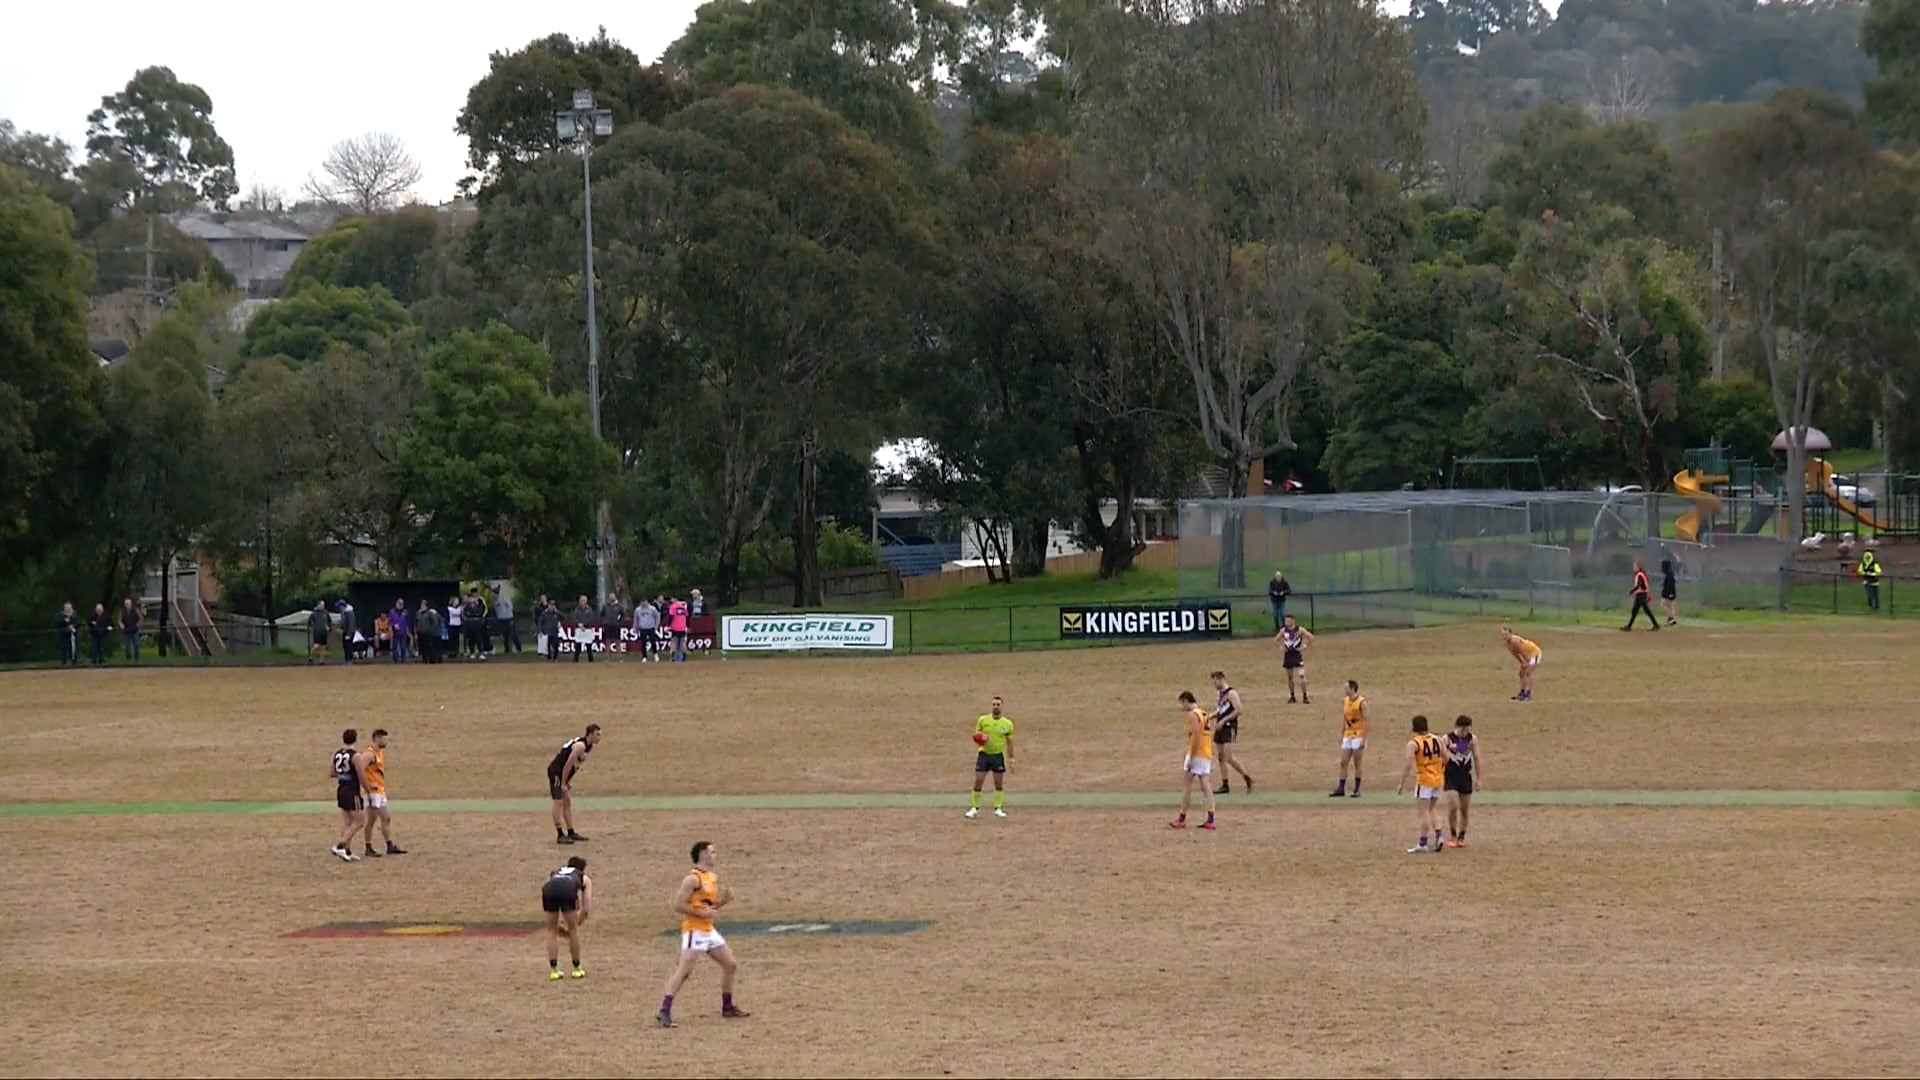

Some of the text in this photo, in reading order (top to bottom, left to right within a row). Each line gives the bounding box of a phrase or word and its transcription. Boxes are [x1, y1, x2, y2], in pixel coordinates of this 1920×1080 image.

[743, 621, 875, 633] KINGFIELD
[1086, 611, 1195, 633] KINGFIELD
[1423, 738, 1440, 760] 44
[335, 753, 351, 773] 23
